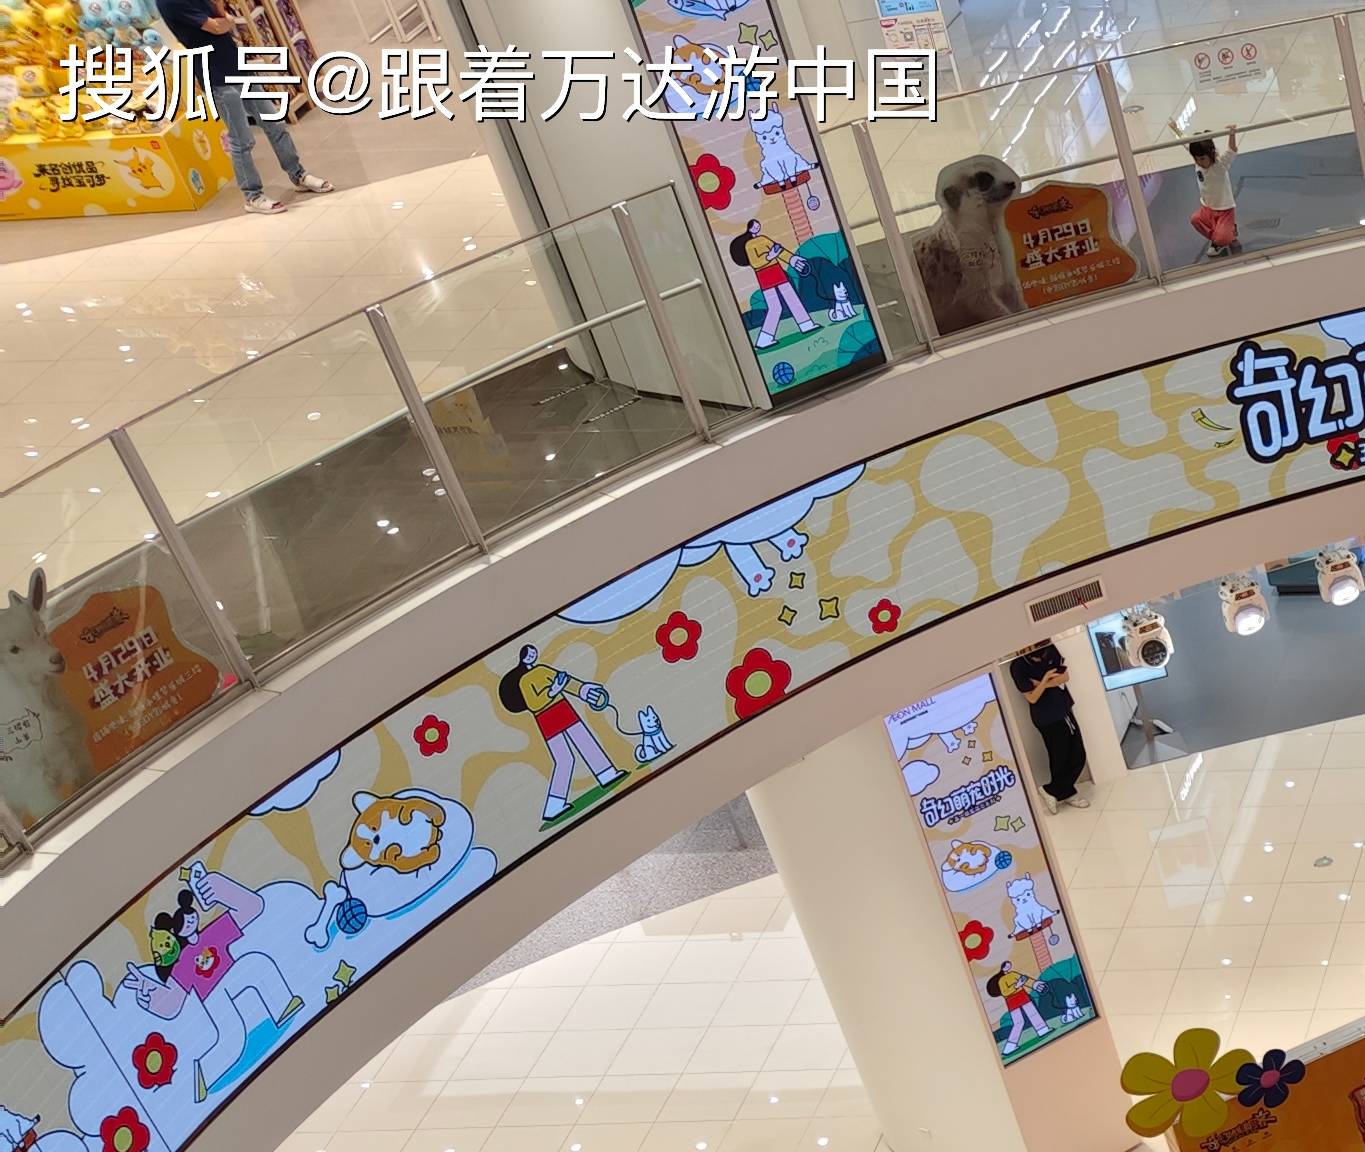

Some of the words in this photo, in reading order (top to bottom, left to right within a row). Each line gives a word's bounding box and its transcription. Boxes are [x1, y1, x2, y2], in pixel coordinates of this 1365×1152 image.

[1022, 218, 1092, 249] 4月29日
[1024, 235, 1100, 271] 盛大开业
[81, 626, 159, 684] 4月29日
[94, 646, 175, 711] 盛大开业
[911, 697, 937, 714] MALL
[920, 766, 1016, 828] 奇幻萌宠时光
